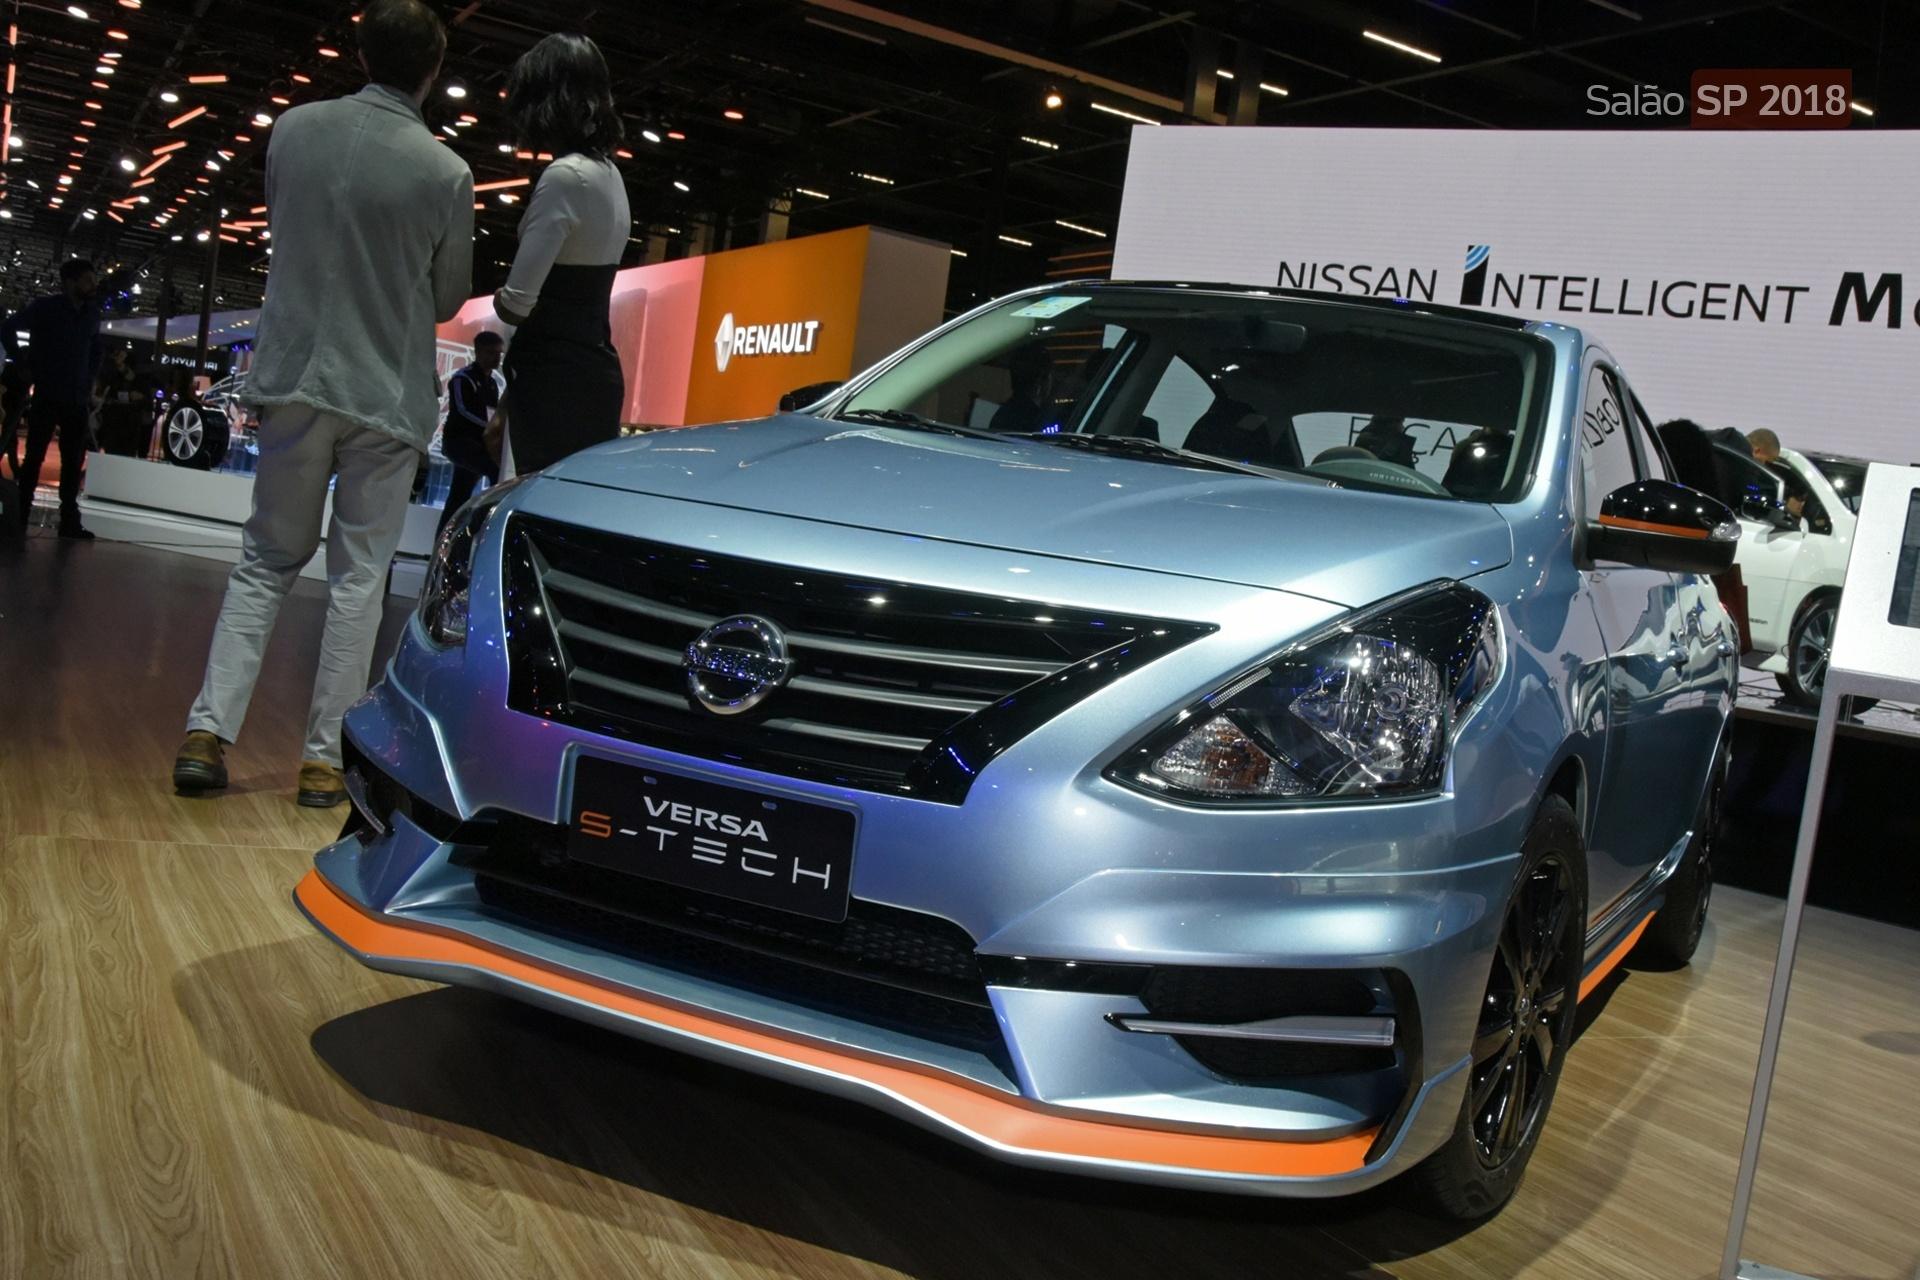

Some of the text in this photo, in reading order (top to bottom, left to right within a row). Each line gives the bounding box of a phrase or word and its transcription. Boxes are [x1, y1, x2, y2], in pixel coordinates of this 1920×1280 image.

[1276, 245, 1920, 330] NISSAN INTELLIGENT M
[732, 320, 819, 356] RENAULT
[580, 810, 832, 890] S-TECH
[642, 795, 769, 842] VERSA
